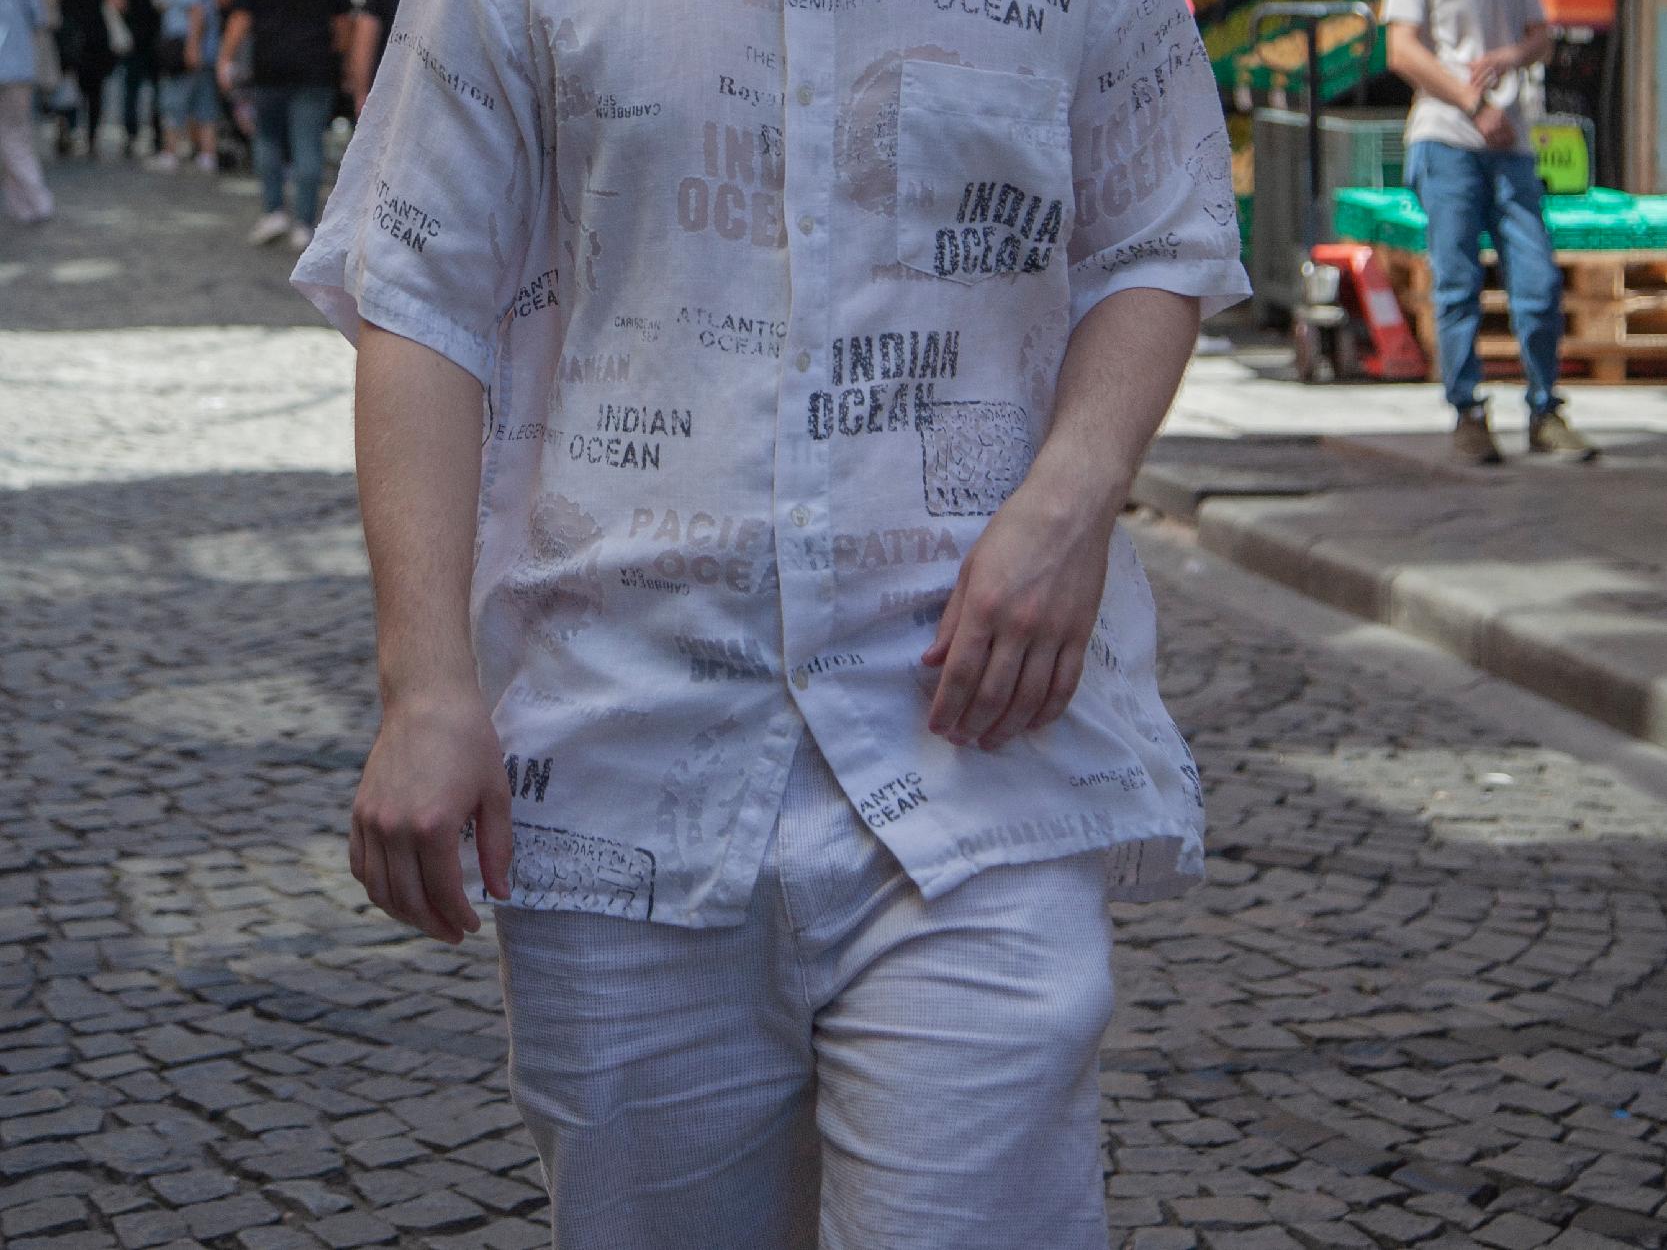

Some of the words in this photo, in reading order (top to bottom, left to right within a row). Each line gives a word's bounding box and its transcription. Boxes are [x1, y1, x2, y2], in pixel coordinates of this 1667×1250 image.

[372, 203, 428, 253] OCEAN
[676, 304, 788, 339] ATLANTIC
[699, 329, 780, 360] OCEAN
[832, 330, 961, 386] INDIAN
[597, 404, 692, 438] INDIAN
[807, 383, 935, 440] OCEAN
[569, 434, 660, 470] OCEAN
